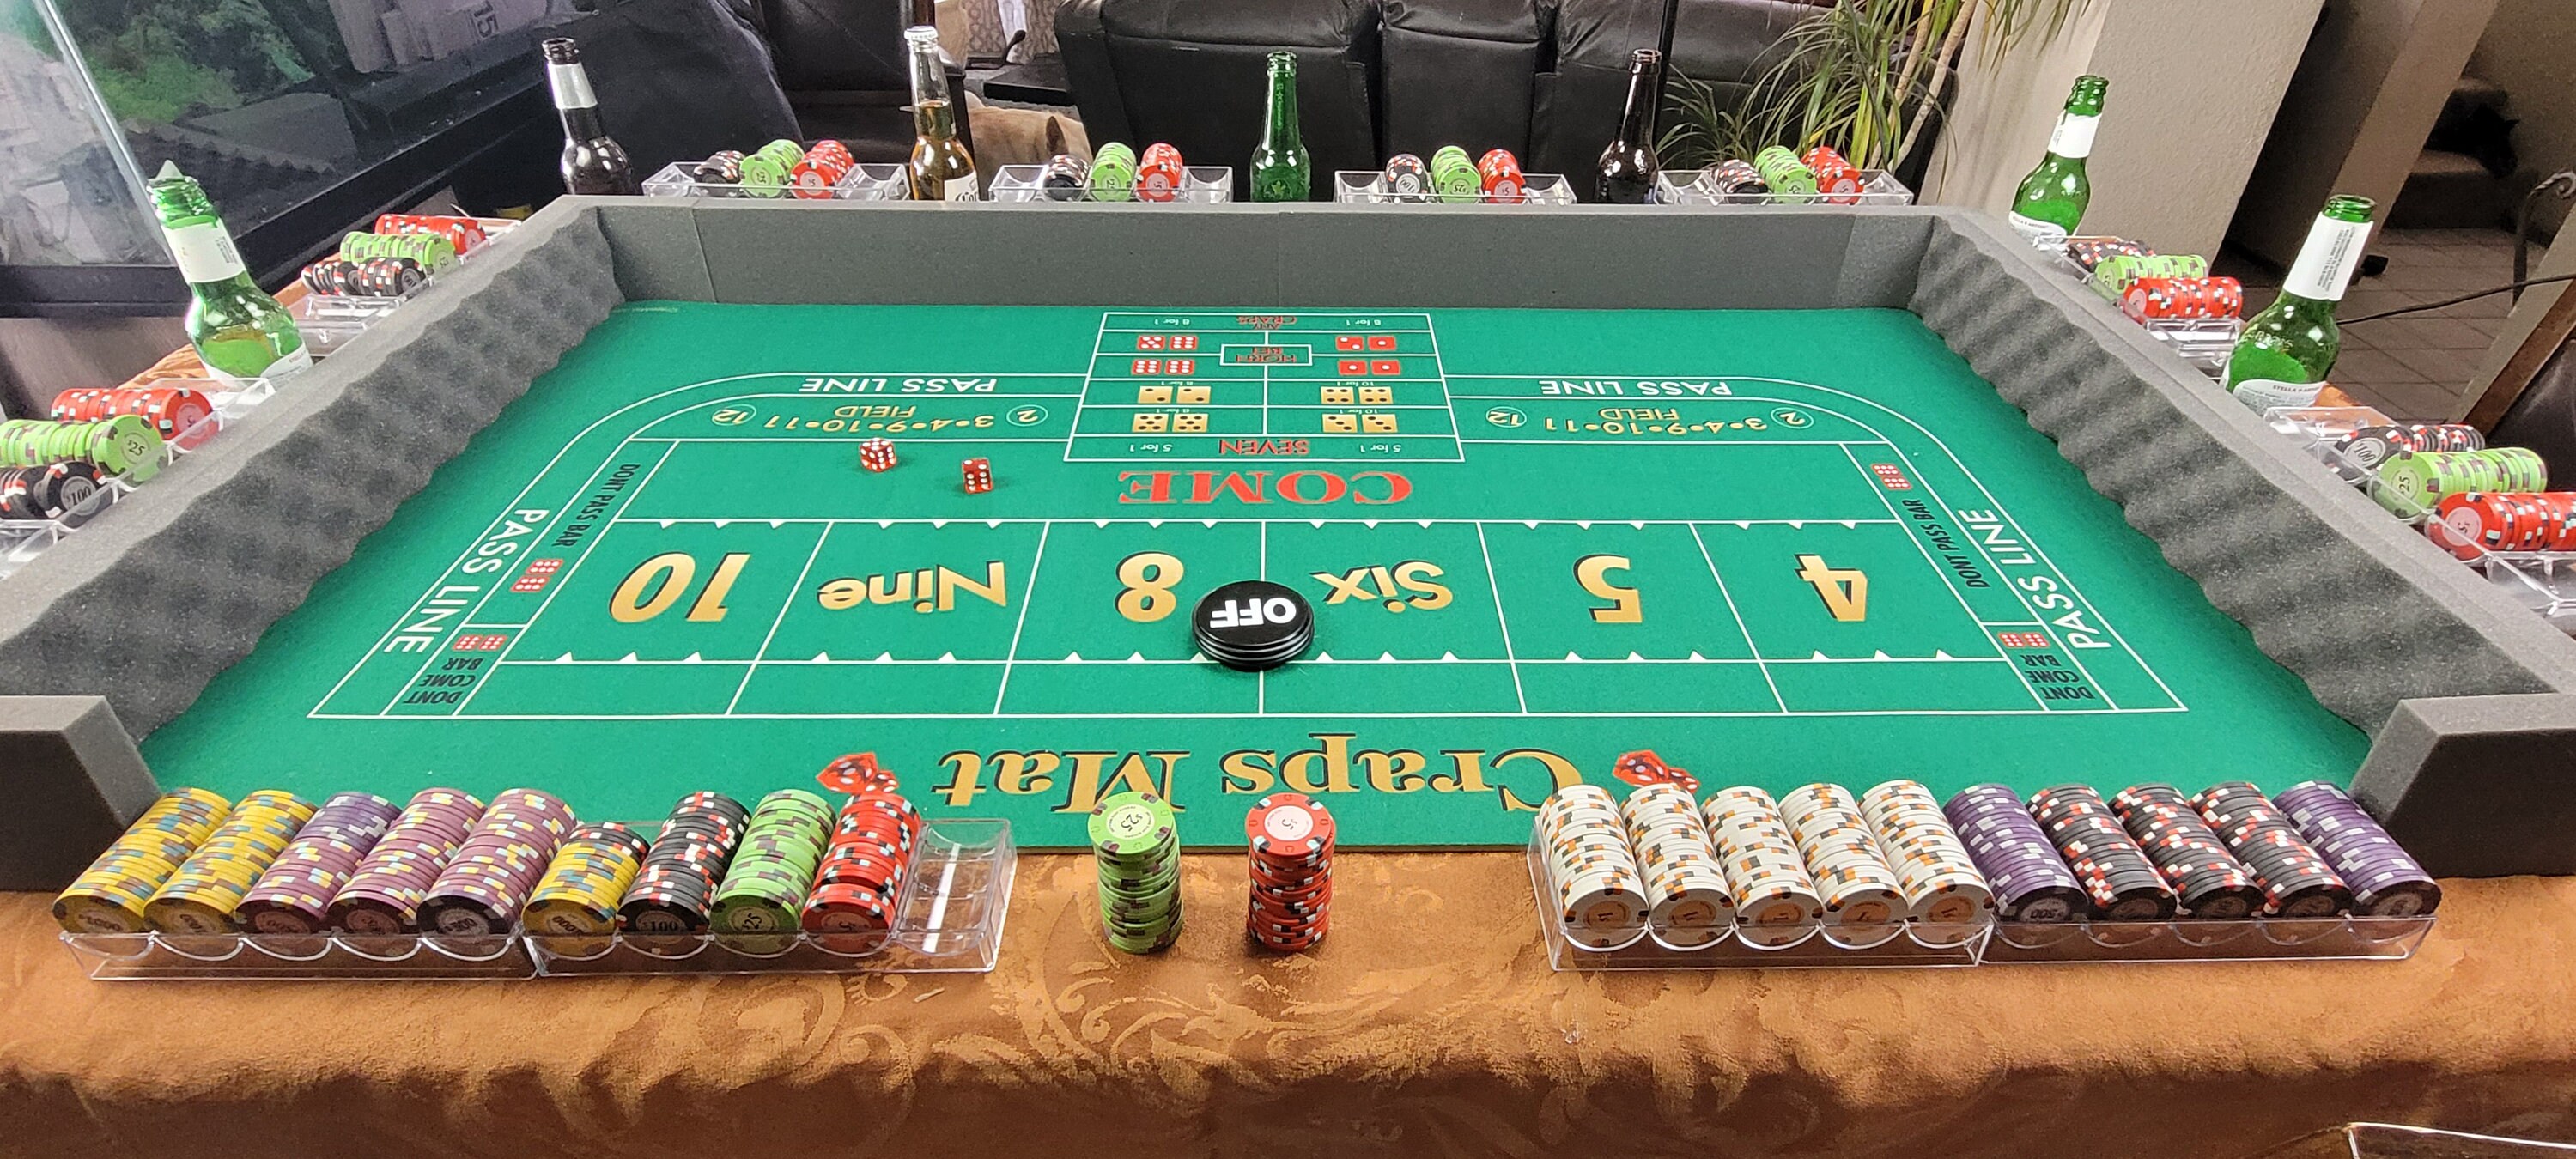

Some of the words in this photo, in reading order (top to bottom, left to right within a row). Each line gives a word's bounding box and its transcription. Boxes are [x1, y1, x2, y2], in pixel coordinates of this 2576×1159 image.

[1236, 315, 1297, 325] CRAPS
[1236, 354, 1297, 364] HORN
[799, 377, 886, 392] LINE
[902, 378, 997, 393] PASS
[1538, 379, 1625, 396] LINE
[1637, 380, 1732, 396] PASS
[713, 408, 750, 424] 12
[834, 404, 917, 418] FIELD
[1016, 409, 1040, 422] 2
[1486, 410, 1522, 427] 12
[1599, 407, 1680, 421] FIELD
[1779, 411, 1805, 425] 2
[127, 440, 146, 457] $25
[1128, 444, 1135, 452] 1
[1139, 444, 1160, 453] for
[1162, 444, 1174, 452] 5
[1219, 439, 1310, 456] SEVEN
[1359, 444, 1366, 452] 1
[1370, 444, 1389, 453] for
[1393, 444, 1402, 453] 5
[2353, 443, 2376, 463] $100
[1117, 470, 1413, 505] COME
[576, 495, 615, 521] PASS
[1901, 499, 1936, 522] BAR
[462, 508, 550, 574] PASS
[552, 524, 591, 547] BAR
[1921, 522, 1960, 555] PASS
[1957, 508, 2037, 566] LINE
[608, 551, 751, 623] 10
[817, 560, 1007, 614] Nine
[1114, 551, 1185, 623] 8
[1309, 559, 1454, 614] Six
[1572, 553, 1643, 623] 5
[1795, 553, 1868, 622] 4
[383, 585, 481, 654] LINE
[1210, 596, 1297, 629] OFF
[2017, 575, 2112, 650] PASS
[441, 658, 483, 671] BAR
[2020, 654, 2062, 667] BAR
[419, 674, 476, 688] COME
[2029, 671, 2080, 683] COME
[404, 690, 465, 704] DONT
[2043, 686, 2095, 701] DONT
[1220, 732, 1584, 811] Craps
[931, 749, 1191, 814] Mat
[1120, 813, 1143, 832] $25
[1281, 818, 1298, 831] $5
[742, 912, 762, 930] $25
